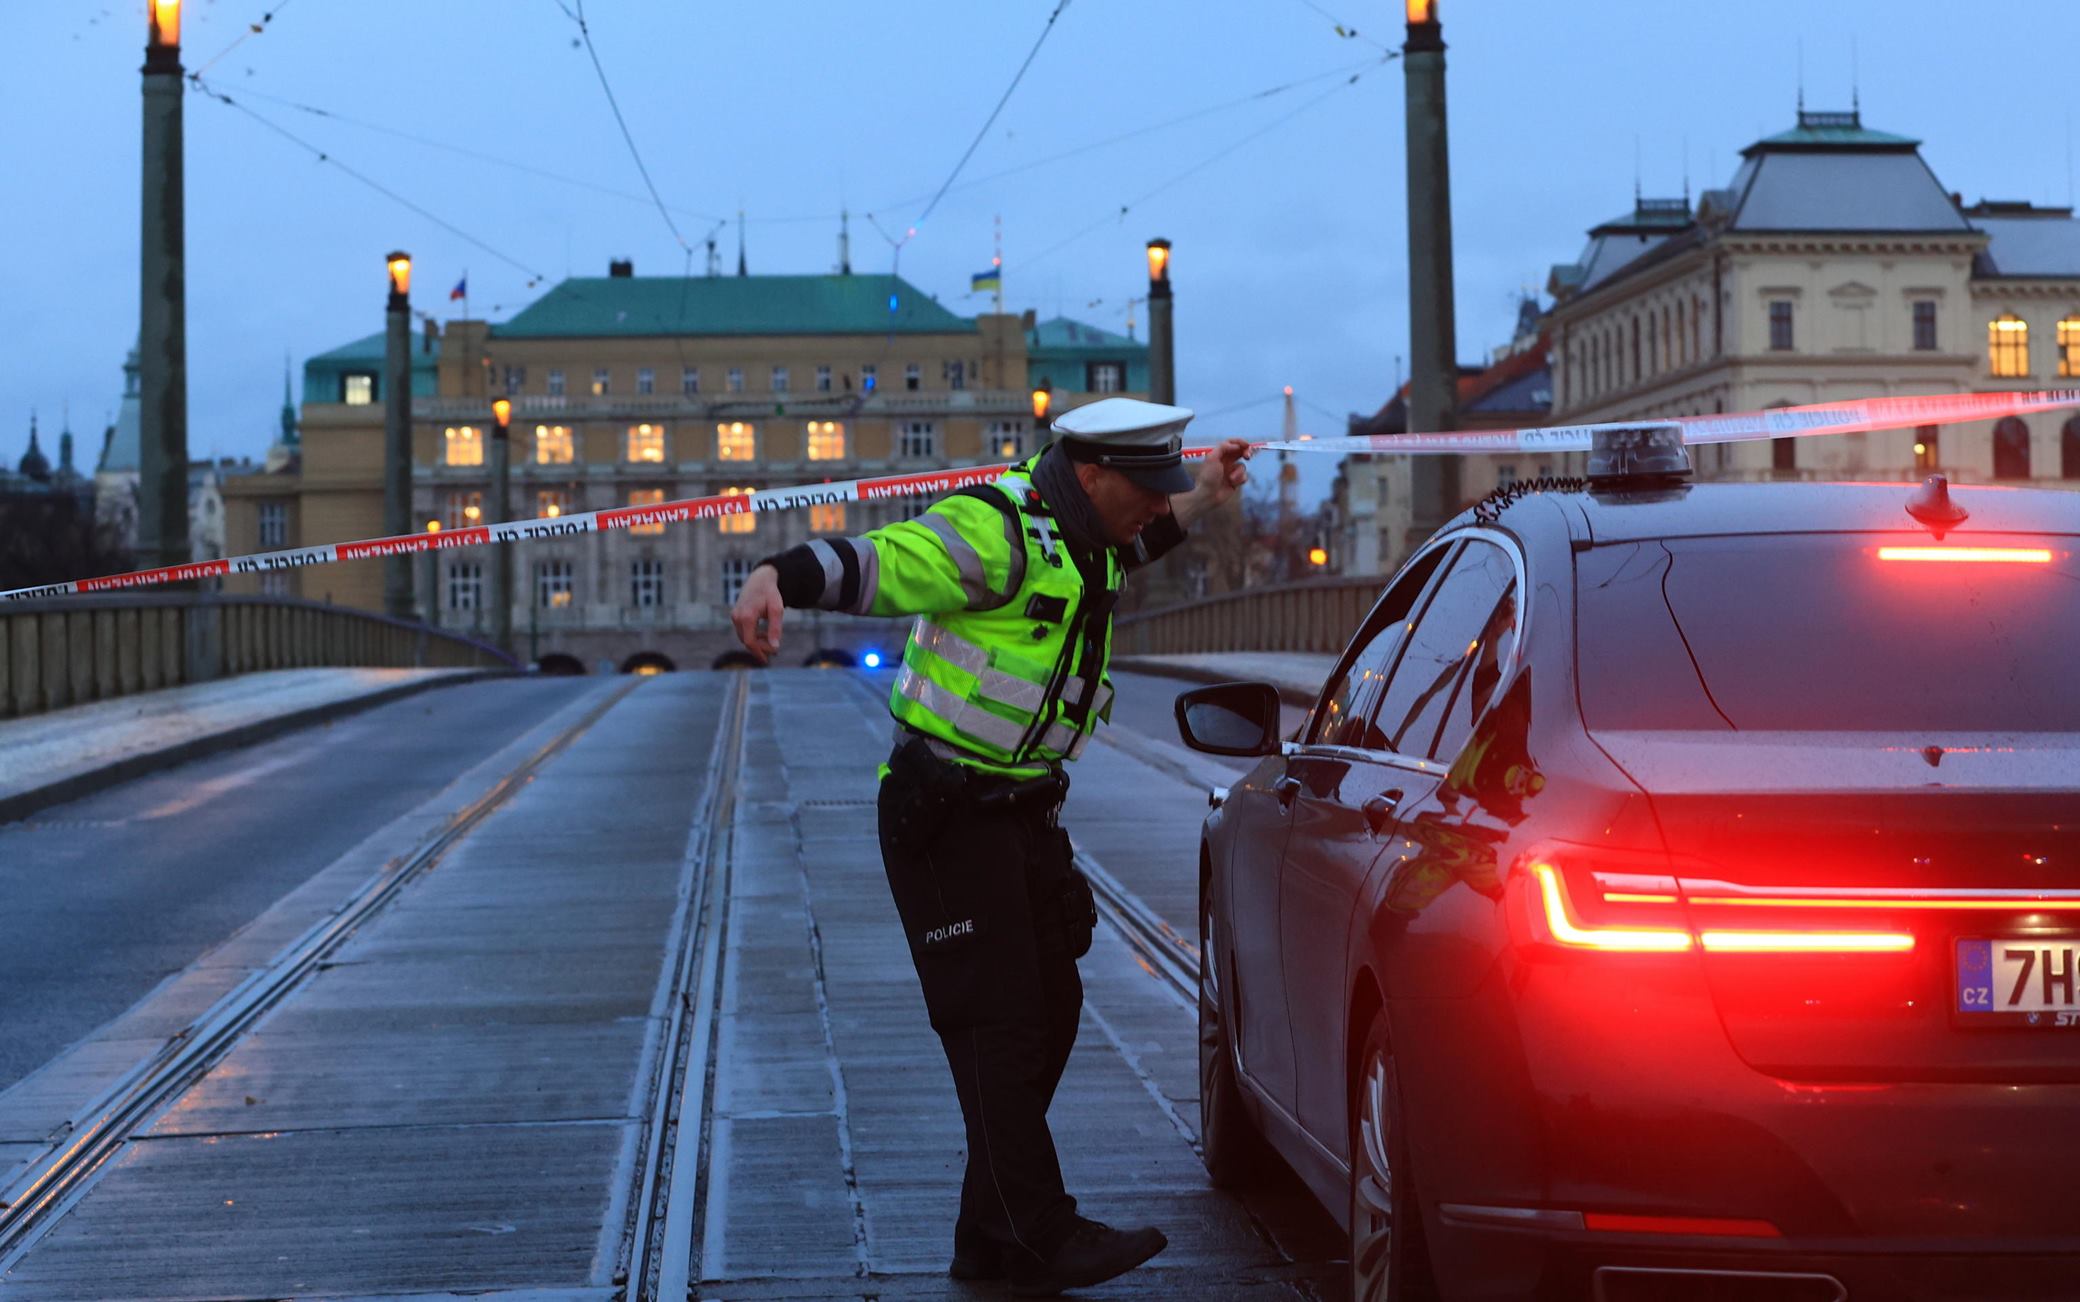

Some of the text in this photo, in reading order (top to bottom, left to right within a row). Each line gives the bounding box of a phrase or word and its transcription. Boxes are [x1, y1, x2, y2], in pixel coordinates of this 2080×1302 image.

[926, 919, 974, 944] POLICIE
[2004, 949, 2080, 1006] 7H
[1963, 987, 1989, 1005] CZ
